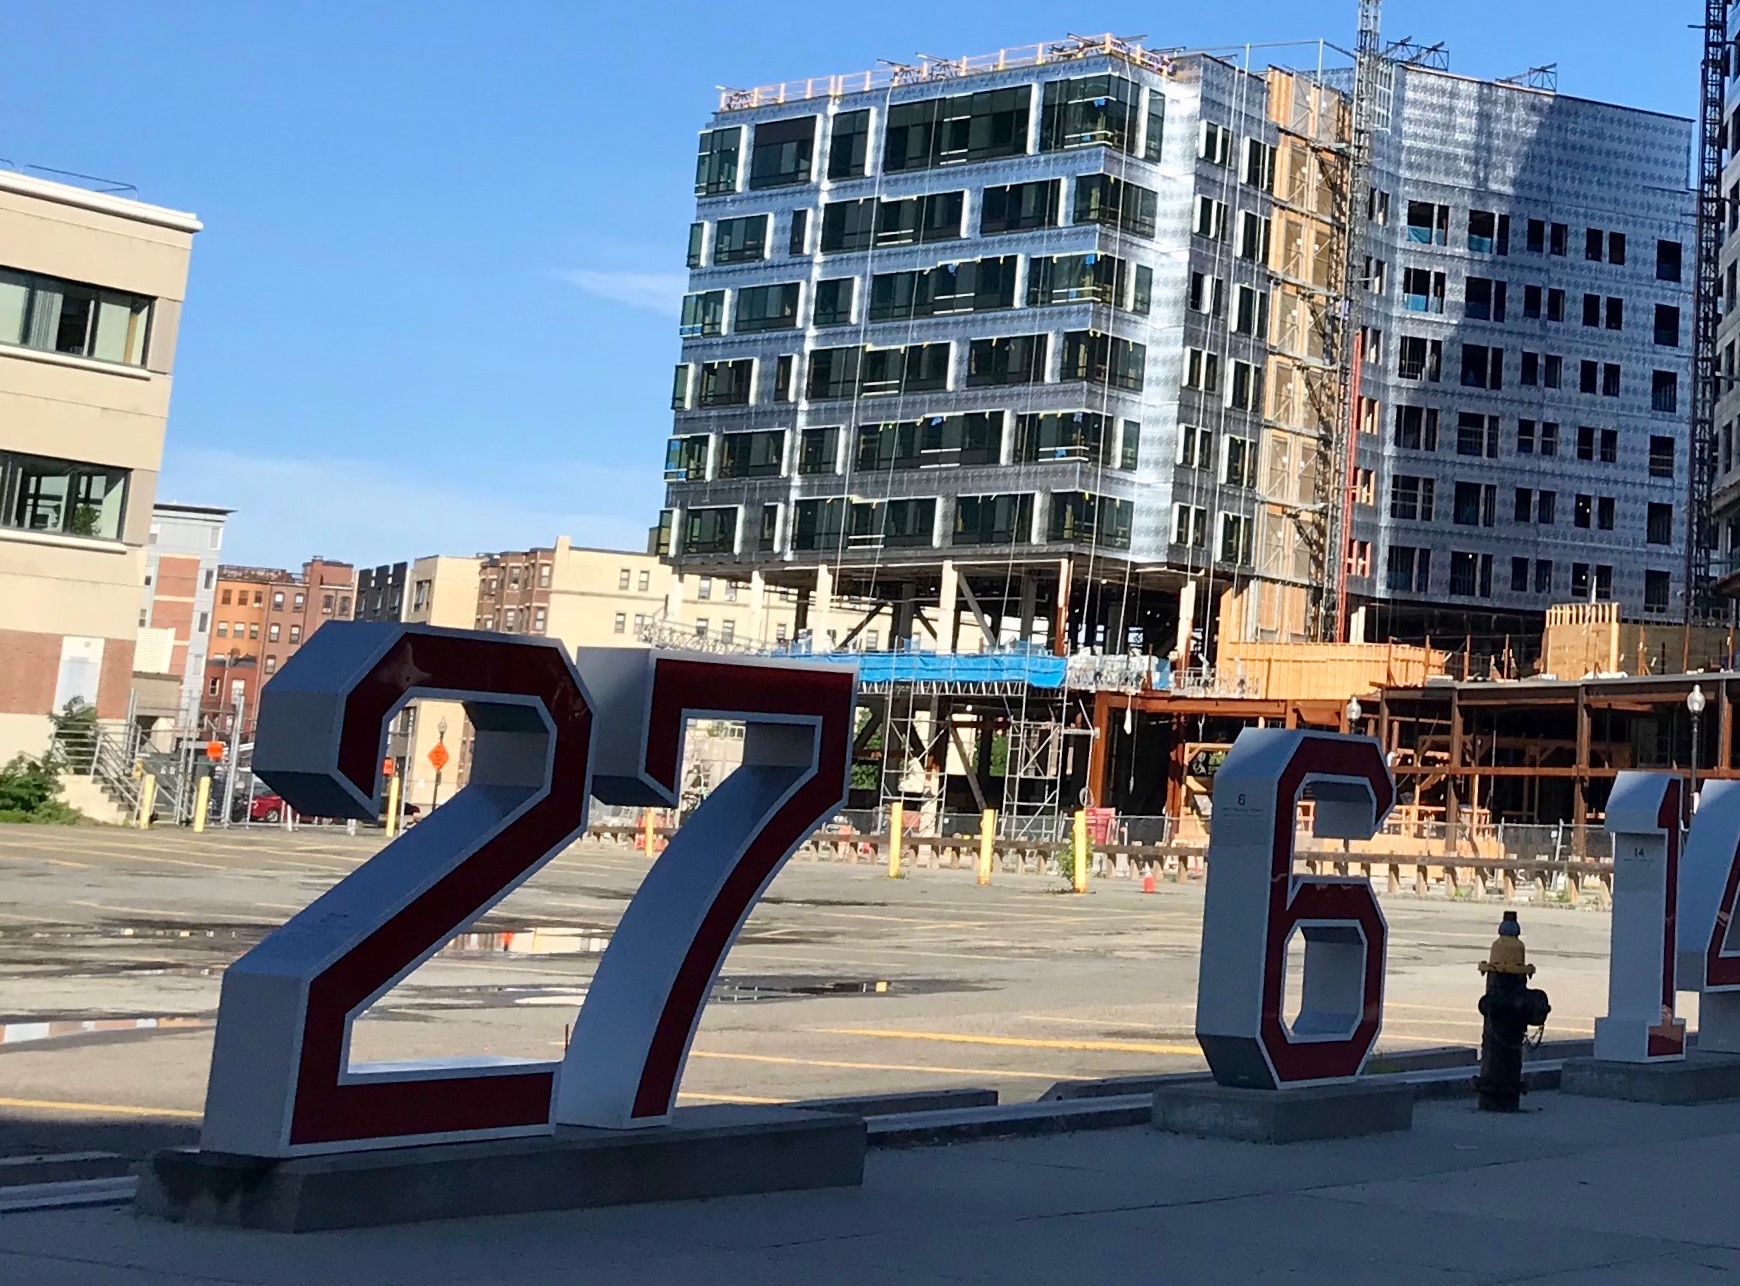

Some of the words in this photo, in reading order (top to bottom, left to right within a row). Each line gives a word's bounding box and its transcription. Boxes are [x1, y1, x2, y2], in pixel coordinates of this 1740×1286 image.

[1237, 793, 1246, 806] 6
[1634, 847, 1645, 858] 14
[283, 628, 861, 1158] 27
[1255, 736, 1398, 1091] 6
